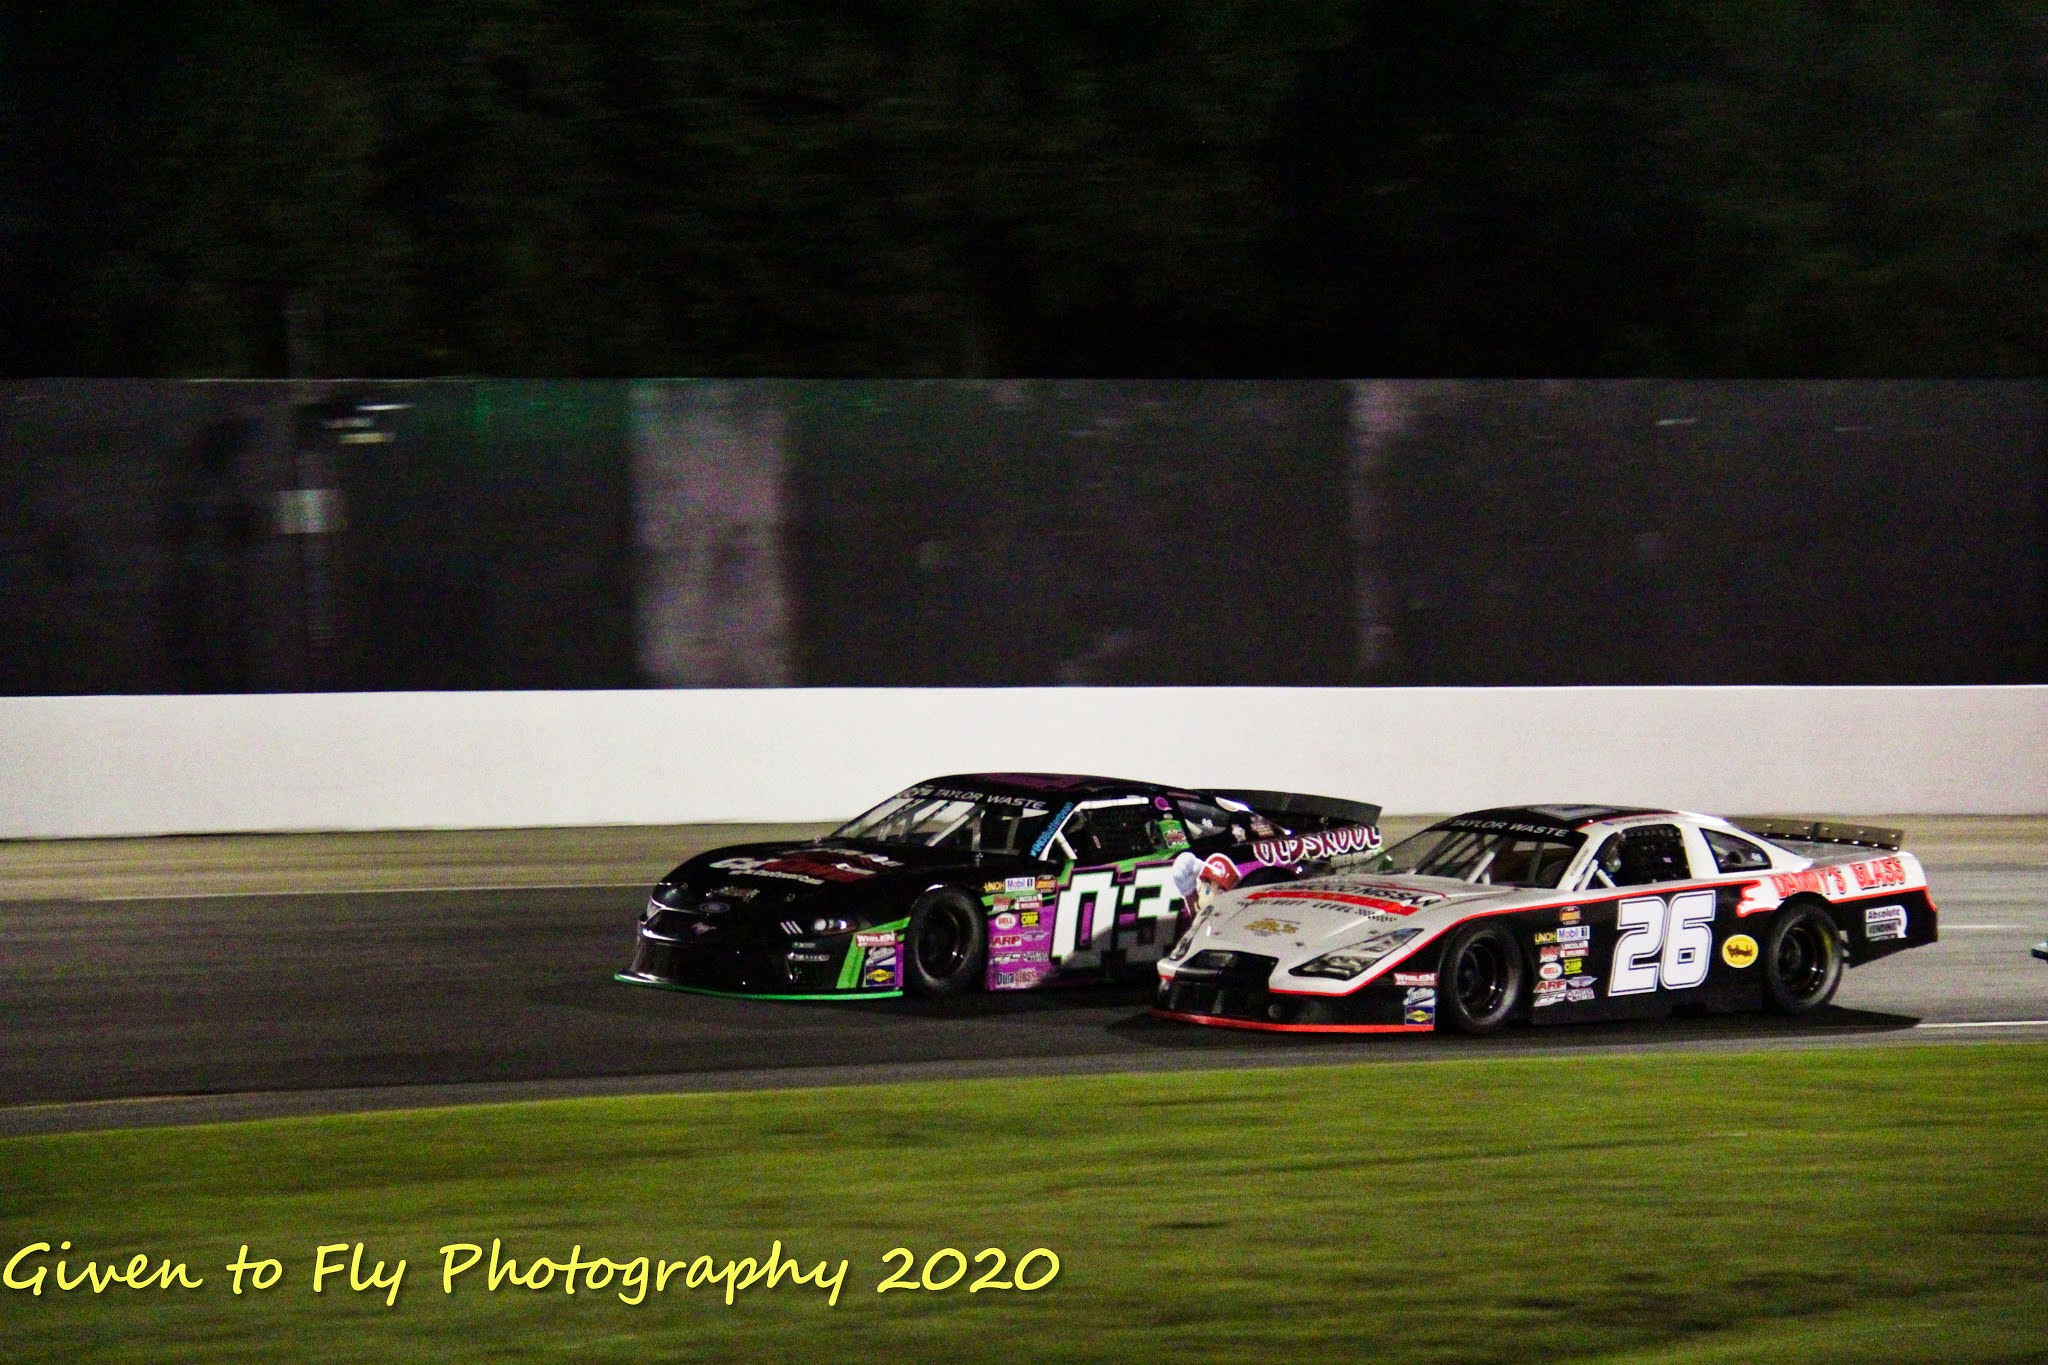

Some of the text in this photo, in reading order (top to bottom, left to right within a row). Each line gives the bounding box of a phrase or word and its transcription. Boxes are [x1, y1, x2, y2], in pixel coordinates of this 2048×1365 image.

[935, 788, 983, 801] TAYLOR
[986, 794, 1047, 809] WASTE
[1451, 819, 1570, 837] TAYLOR WASTE
[1849, 856, 1905, 891] GLASS
[1021, 914, 1039, 925] OMP
[1052, 865, 1184, 970] 03
[1868, 908, 1901, 920] Absolute
[991, 935, 1021, 947] ARP
[1534, 930, 1557, 945] UNOH
[1607, 889, 1716, 997] 26
[1536, 980, 1567, 991] ARP
